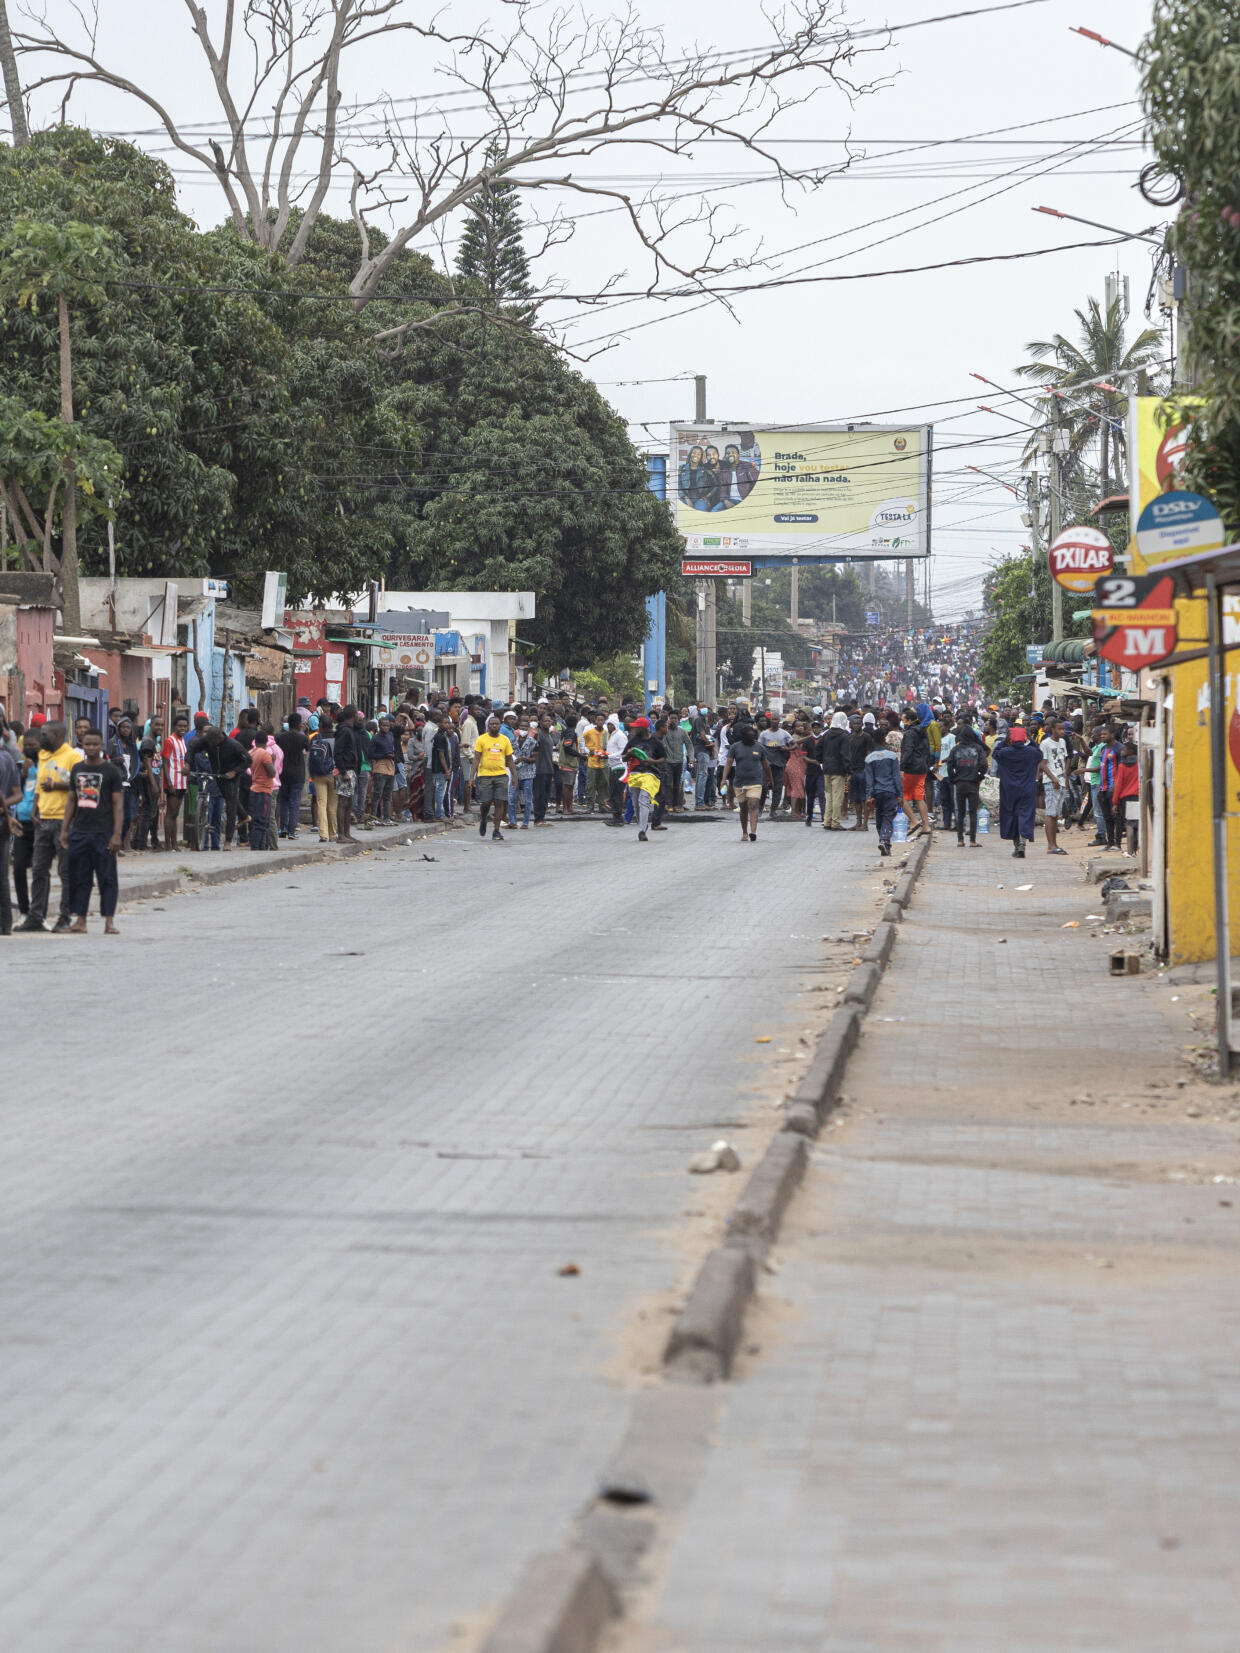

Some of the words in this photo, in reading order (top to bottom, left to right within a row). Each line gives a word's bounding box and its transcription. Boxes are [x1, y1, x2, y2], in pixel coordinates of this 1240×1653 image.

[774, 463, 796, 473] hoje
[823, 475, 851, 483] nada.
[1053, 547, 1110, 570] TXILAR
[1101, 578, 1137, 607] 2
[1124, 628, 1166, 655] M
